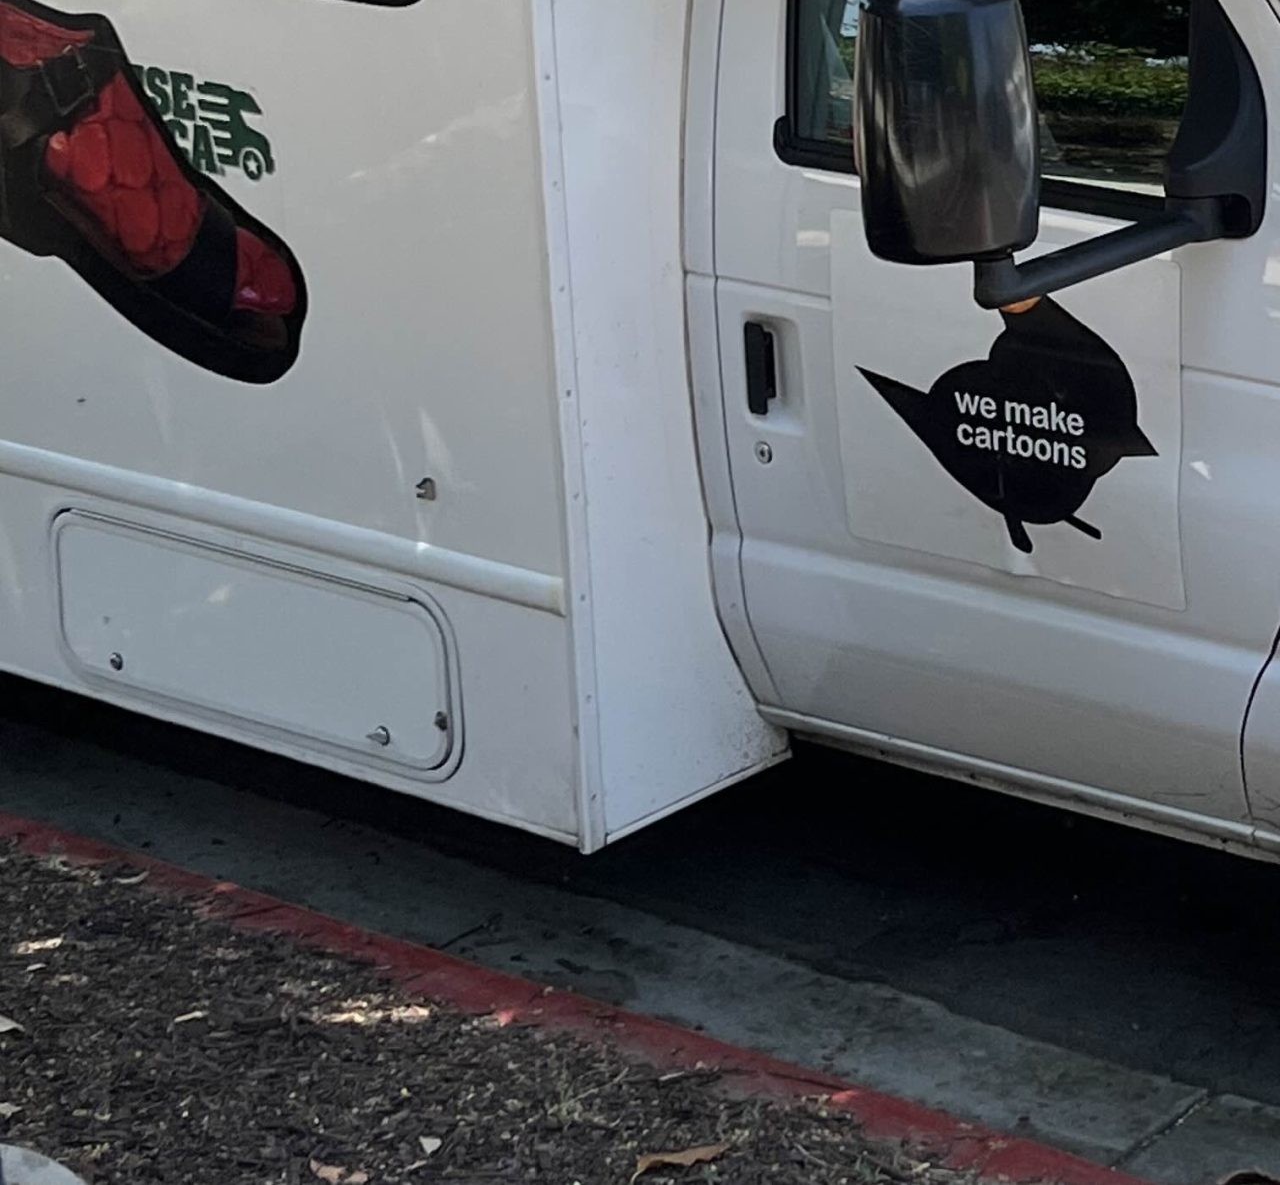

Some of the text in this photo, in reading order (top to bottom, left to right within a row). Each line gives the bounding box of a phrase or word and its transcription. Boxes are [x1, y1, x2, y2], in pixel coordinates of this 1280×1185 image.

[954, 391, 1085, 436] we make
[956, 423, 1087, 469] cartoons
